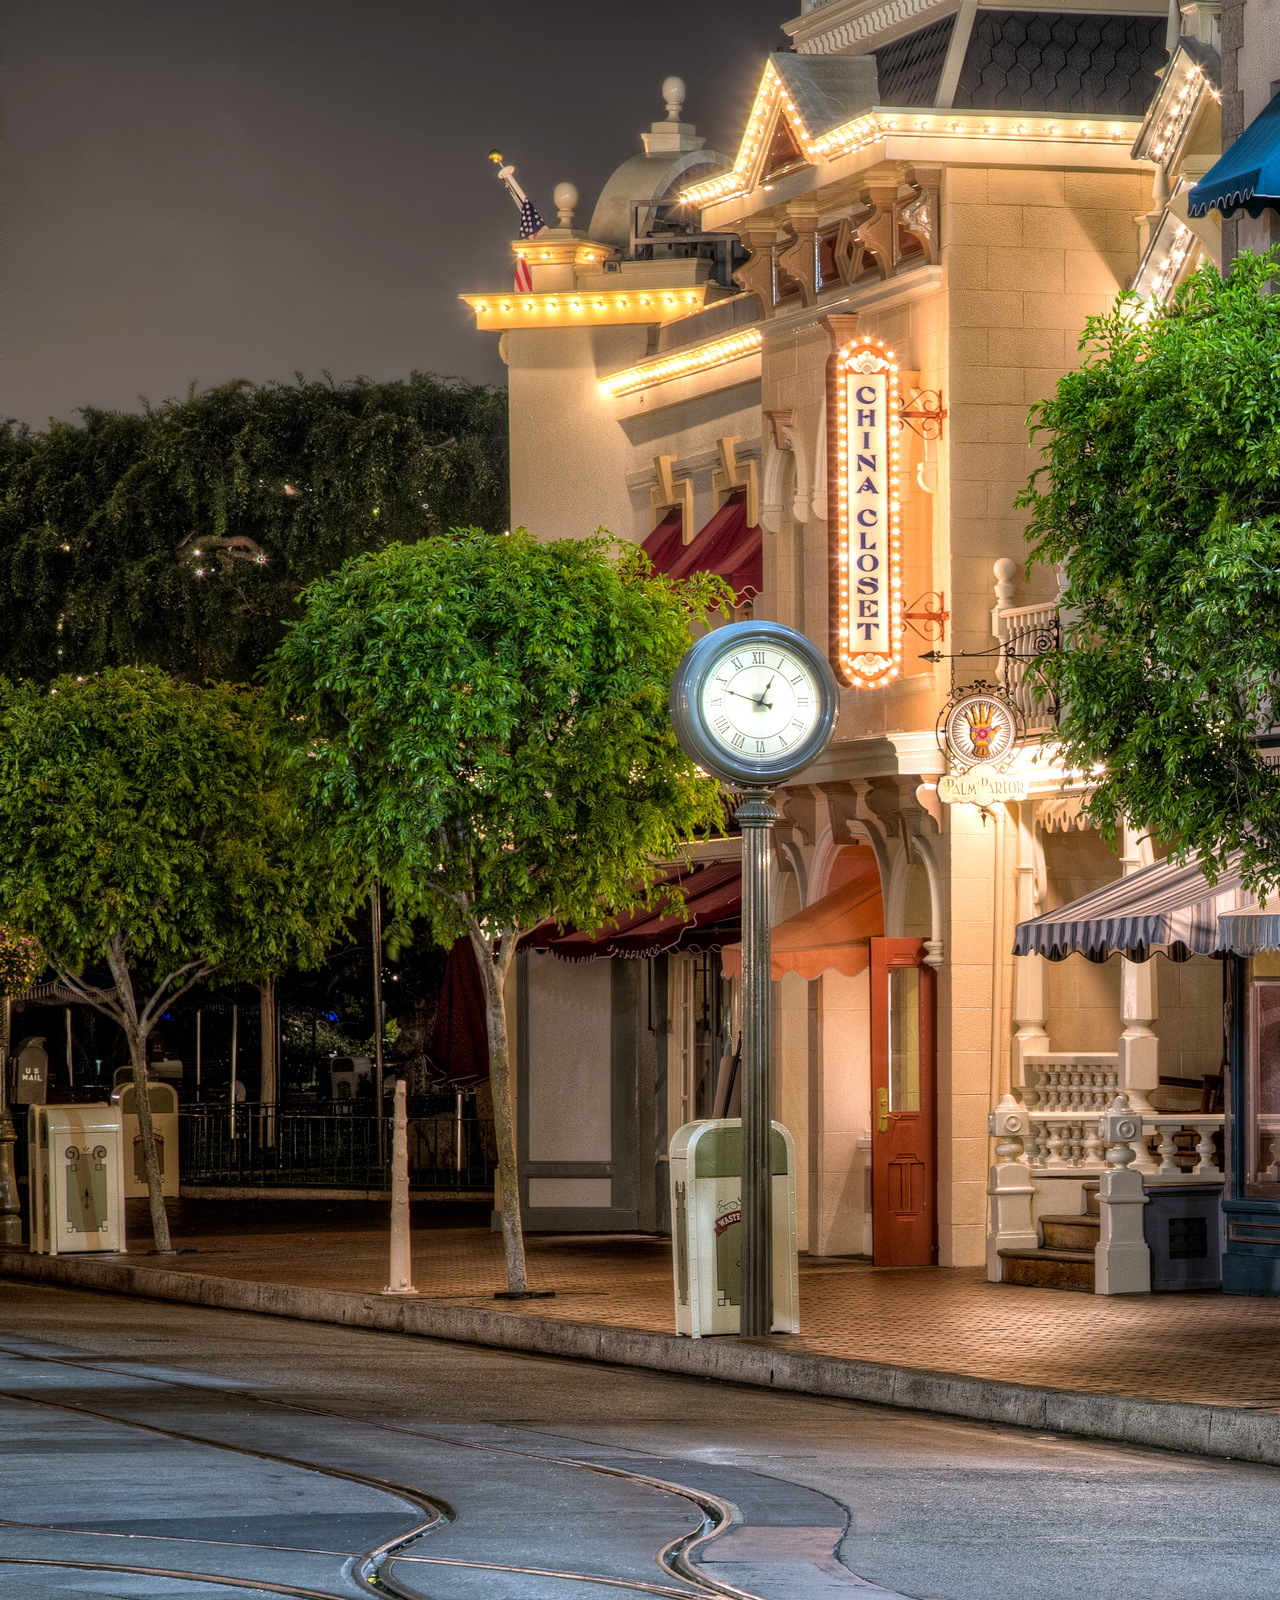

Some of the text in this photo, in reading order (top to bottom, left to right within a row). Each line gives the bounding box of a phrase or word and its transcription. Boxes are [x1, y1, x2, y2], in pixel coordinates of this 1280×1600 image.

[856, 386, 880, 641] CHINA CLOSET
[730, 656, 743, 671] XI
[752, 651, 765, 664] XII
[716, 675, 728, 685] X
[791, 675, 803, 686] II
[797, 697, 809, 708] III
[730, 732, 745, 749] VII
[756, 740, 765, 753] VI
[778, 735, 787, 747] V
[943, 778, 1024, 798] PALM PARLOR
[717, 1213, 741, 1227] WASTE
